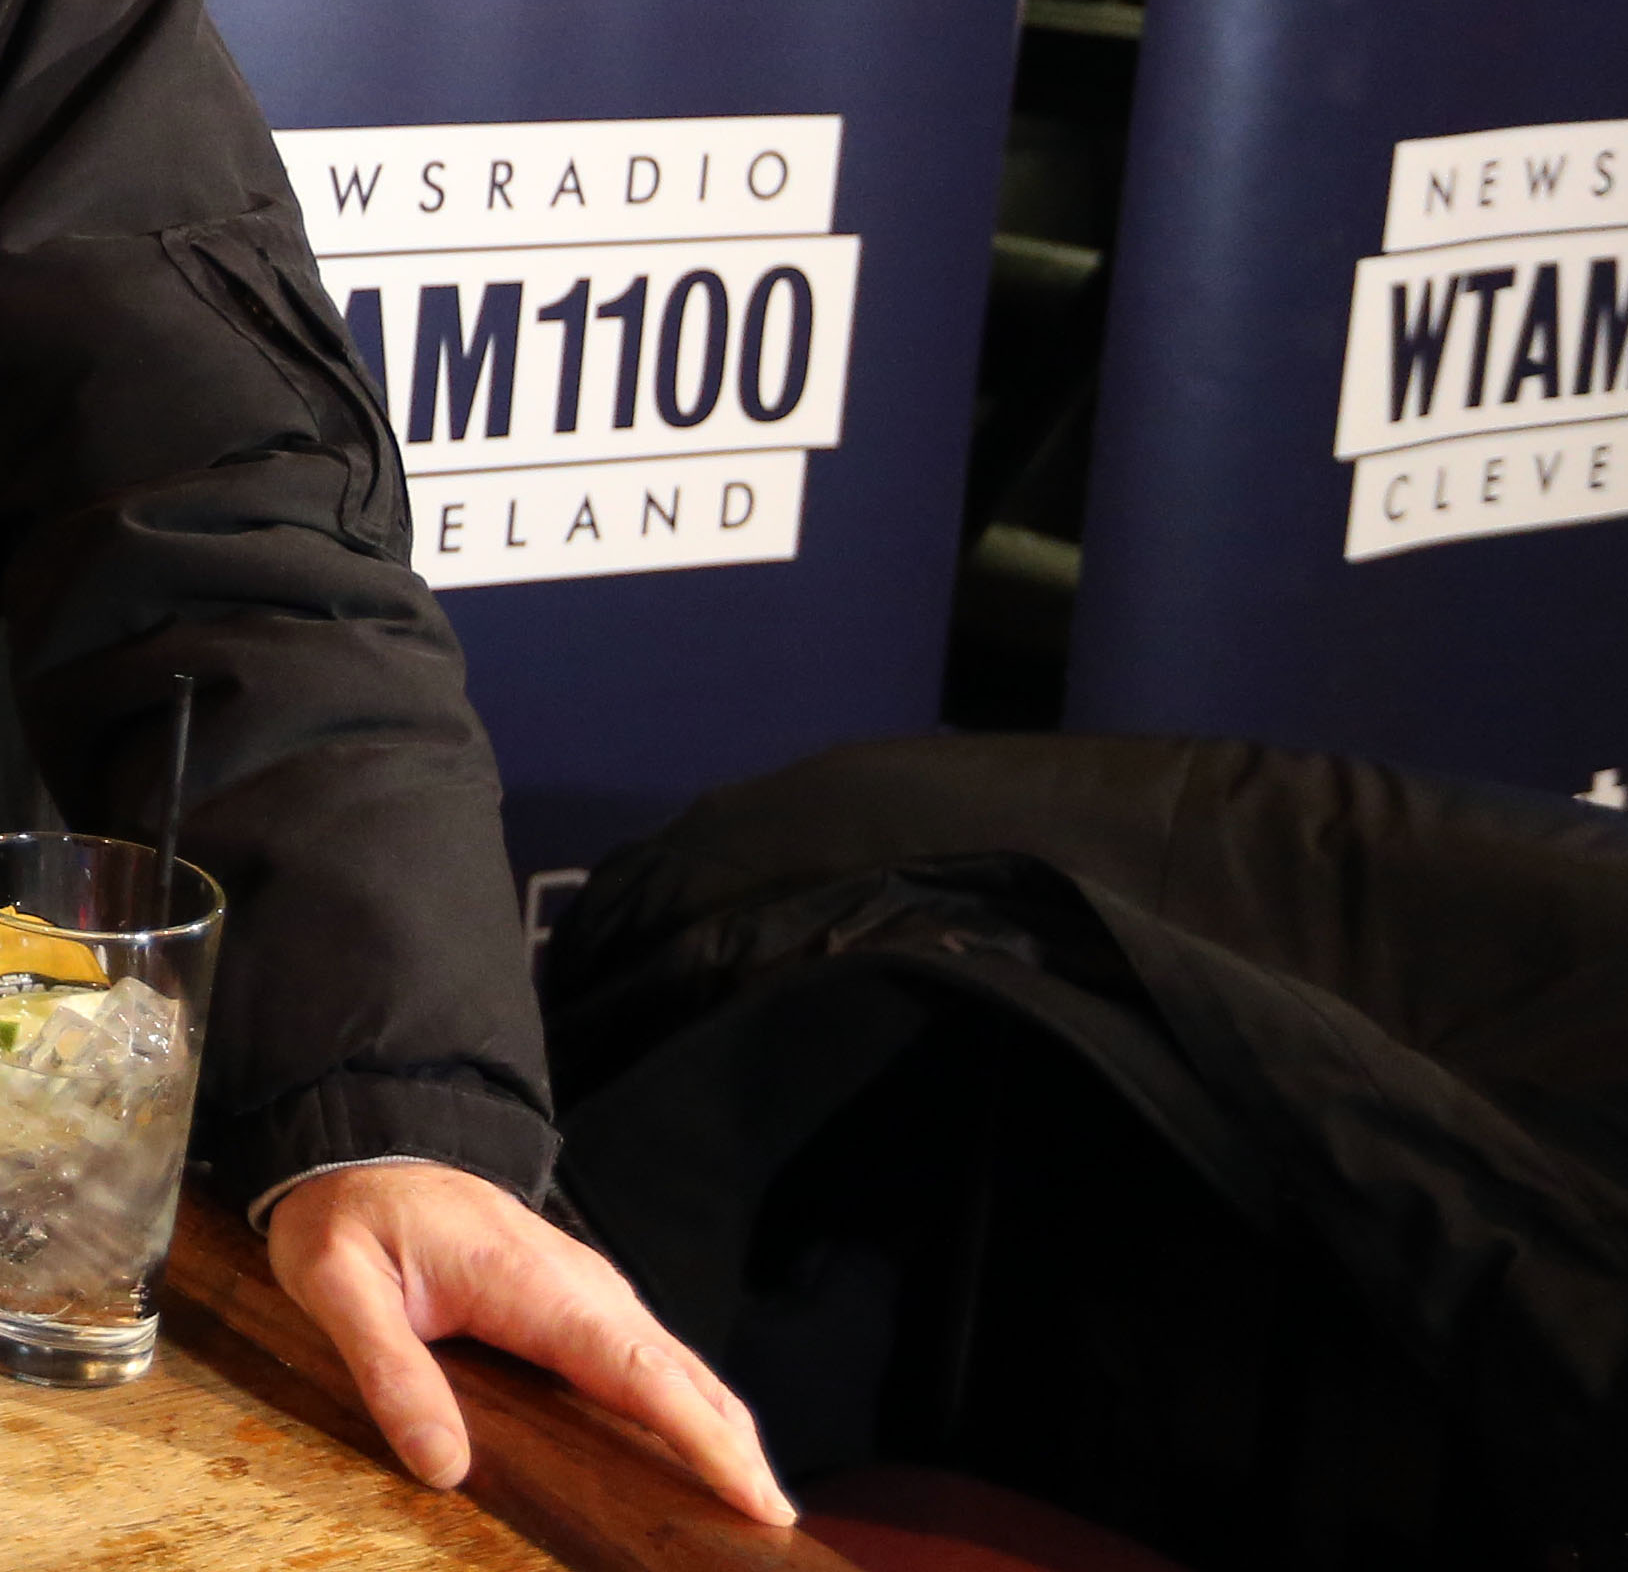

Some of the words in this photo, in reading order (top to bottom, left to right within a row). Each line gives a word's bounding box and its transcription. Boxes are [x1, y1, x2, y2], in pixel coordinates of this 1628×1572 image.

[328, 150, 790, 216] WSRADIO
[342, 264, 814, 444] AM1100
[1387, 257, 1628, 425] WTAM
[438, 482, 757, 554] ELAND
[1382, 444, 1613, 524] CLEVE
